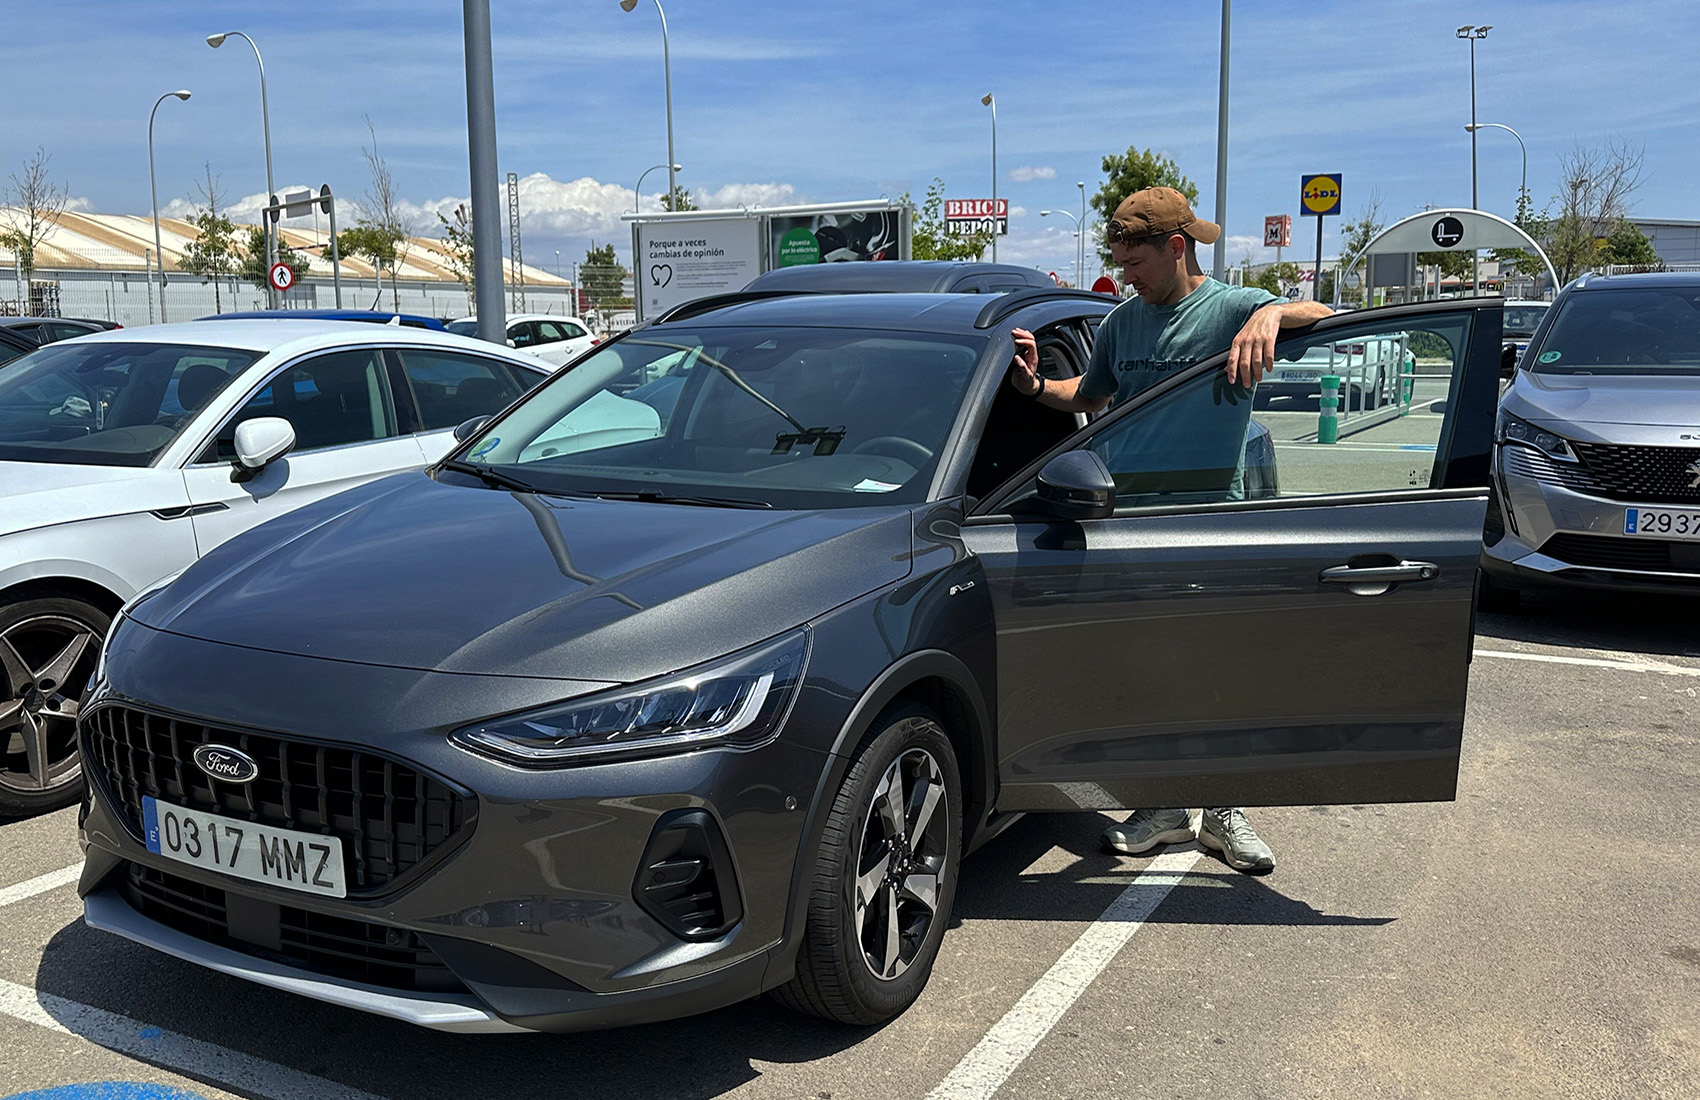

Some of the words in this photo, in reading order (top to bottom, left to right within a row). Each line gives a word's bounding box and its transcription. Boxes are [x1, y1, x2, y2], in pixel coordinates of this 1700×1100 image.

[948, 200, 1005, 215] BRICO
[1269, 228, 1279, 239] M
[649, 240, 677, 250] Porque
[685, 239, 707, 247] veces
[649, 248, 681, 259] cambias
[683, 249, 692, 257] de
[694, 247, 724, 259] opinión
[1641, 512, 1700, 534] 2937
[205, 751, 240, 776] Ford
[150, 830, 157, 843] E
[164, 811, 244, 868] 0317
[259, 833, 334, 889] MMZ
